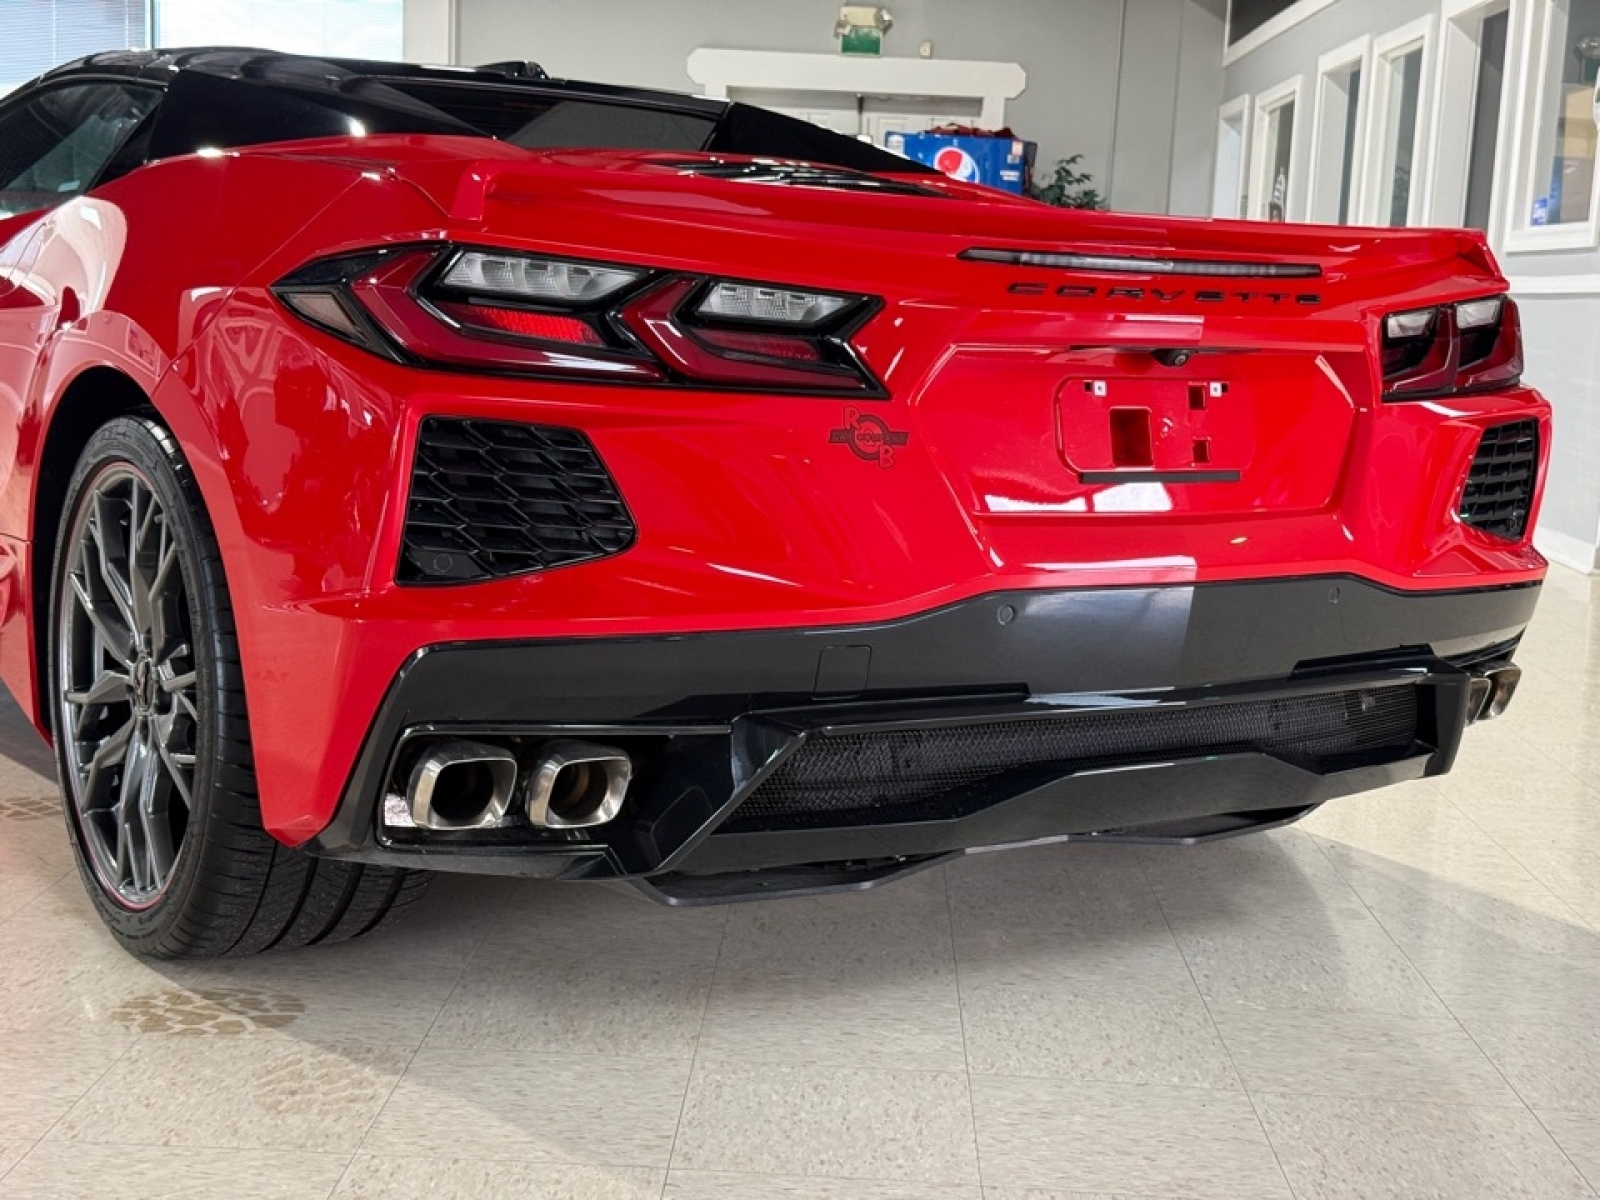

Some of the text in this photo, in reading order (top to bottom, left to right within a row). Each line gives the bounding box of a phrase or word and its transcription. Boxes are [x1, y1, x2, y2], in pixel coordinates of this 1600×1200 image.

[1008, 282, 1321, 304] CORVETTE
[843, 405, 861, 429] R
[878, 445, 895, 468] B
